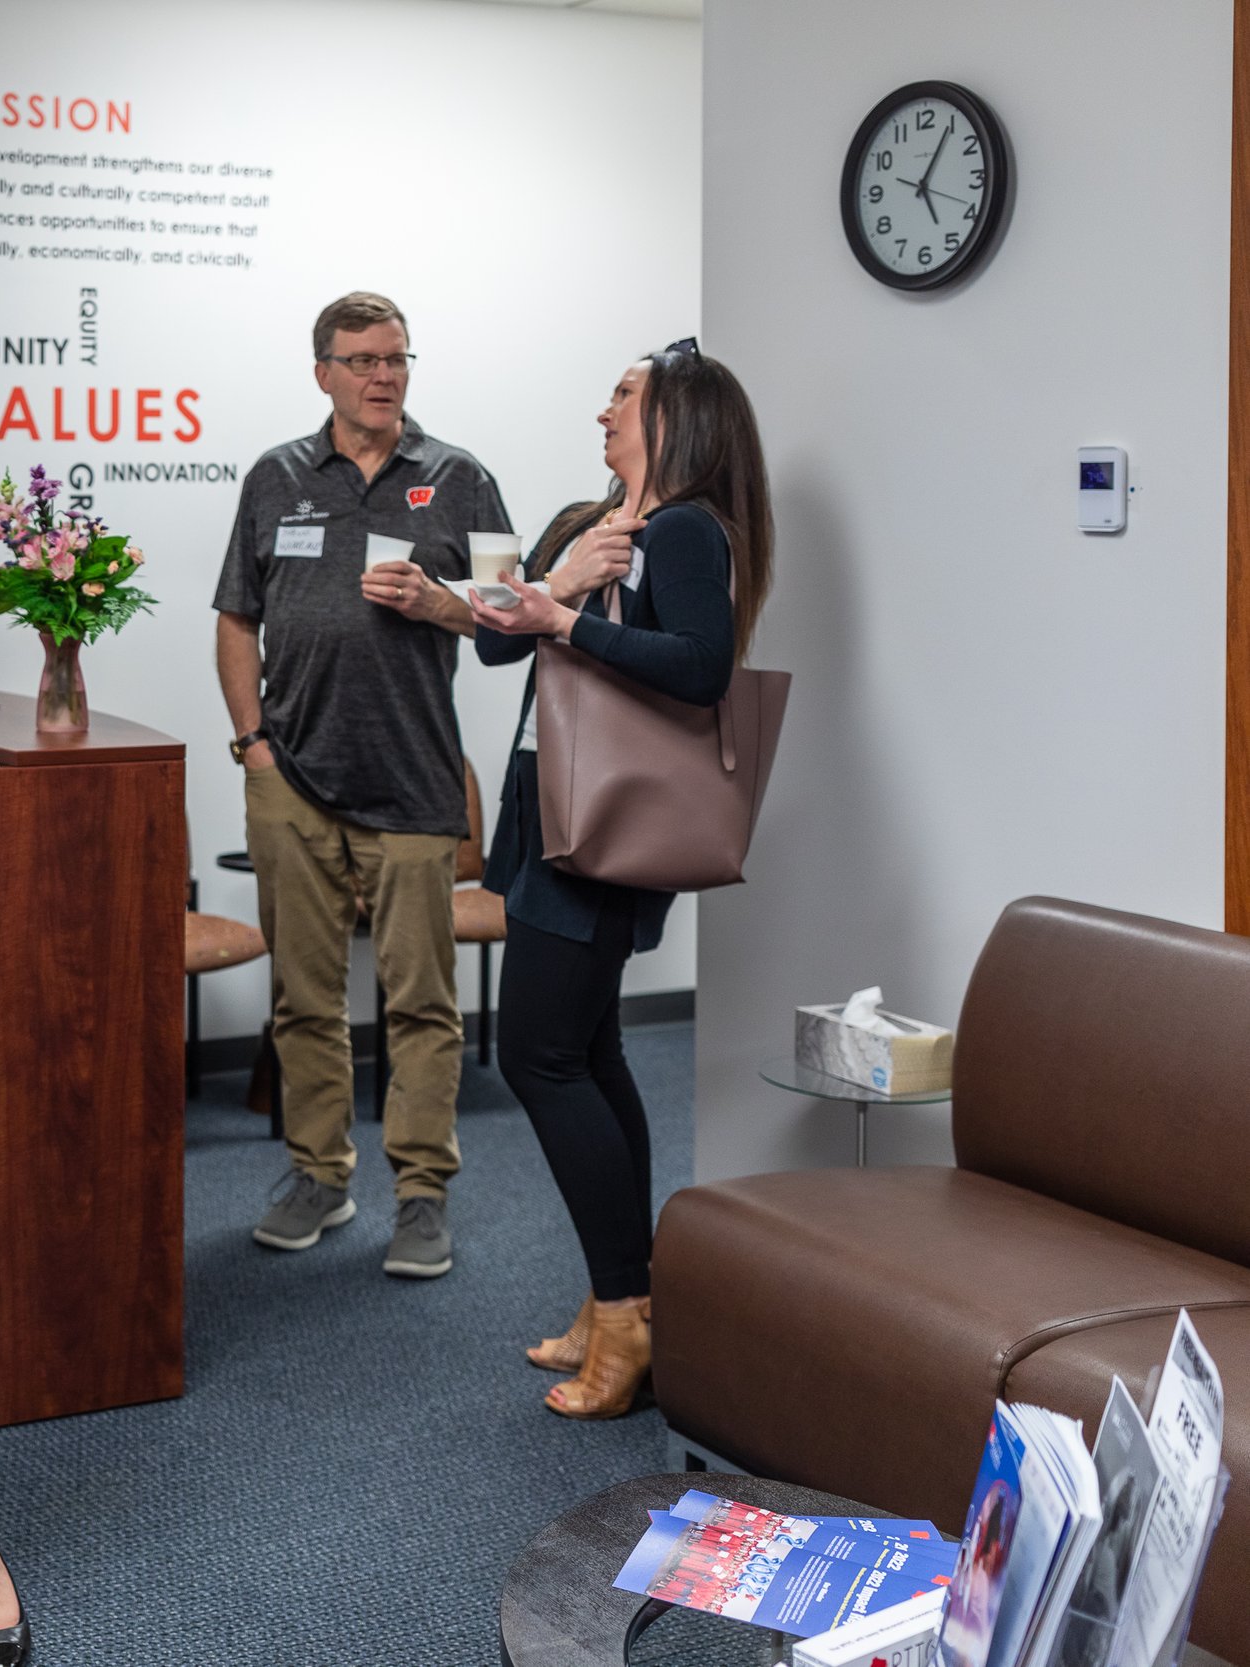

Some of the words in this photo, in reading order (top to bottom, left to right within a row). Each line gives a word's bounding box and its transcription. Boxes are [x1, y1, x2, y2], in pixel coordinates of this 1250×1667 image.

[916, 109, 936, 131] 12
[949, 114, 956, 135] 1
[894, 123, 908, 145] 11
[962, 135, 979, 157] 2
[92, 153, 184, 175] strengthens
[188, 162, 214, 176] our
[219, 162, 274, 178] diverse
[876, 150, 893, 172] 10
[968, 168, 985, 190] 3
[20, 180, 54, 197] and
[58, 183, 134, 203] culturally
[138, 188, 226, 207] competent
[230, 193, 271, 208] adult
[868, 184, 885, 204] 9
[962, 202, 978, 224] 4
[39, 213, 147, 233] opportunities
[150, 219, 166, 233] to
[170, 223, 223, 236] ensure
[227, 223, 258, 238] that
[875, 216, 893, 236] 8
[894, 238, 908, 259] 7
[943, 232, 961, 253] 5
[29, 243, 147, 264] economically,
[150, 249, 183, 265] and
[917, 245, 934, 266] 6
[78, 286, 99, 367] EQUITY
[103, 461, 238, 483] INNOVATION
